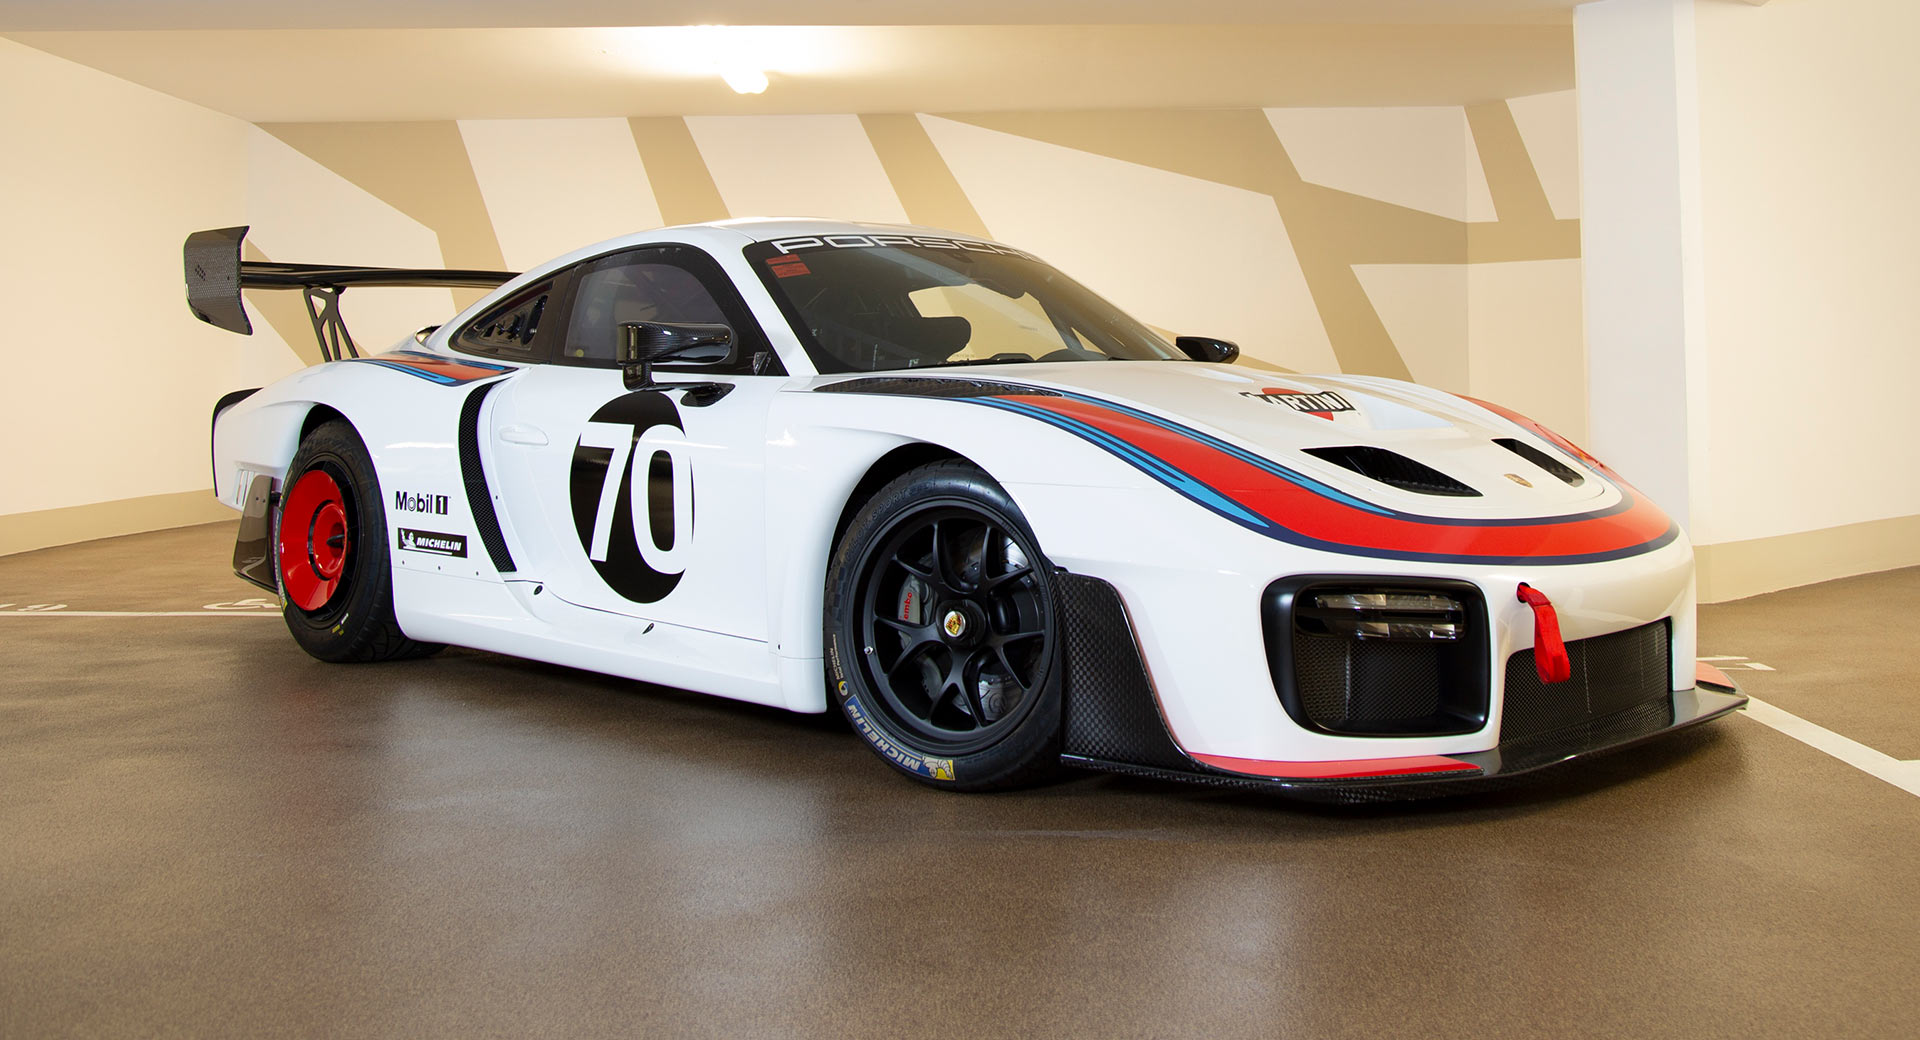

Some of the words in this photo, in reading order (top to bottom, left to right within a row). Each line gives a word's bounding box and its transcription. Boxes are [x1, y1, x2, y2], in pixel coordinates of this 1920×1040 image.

[1239, 391, 1356, 412] ARTINI
[395, 491, 433, 513] Mobil
[437, 496, 446, 515] 1
[579, 421, 692, 575] 70
[416, 537, 462, 551] MICHELIN
[903, 592, 913, 620] embo
[848, 704, 921, 771] MICHELIN
